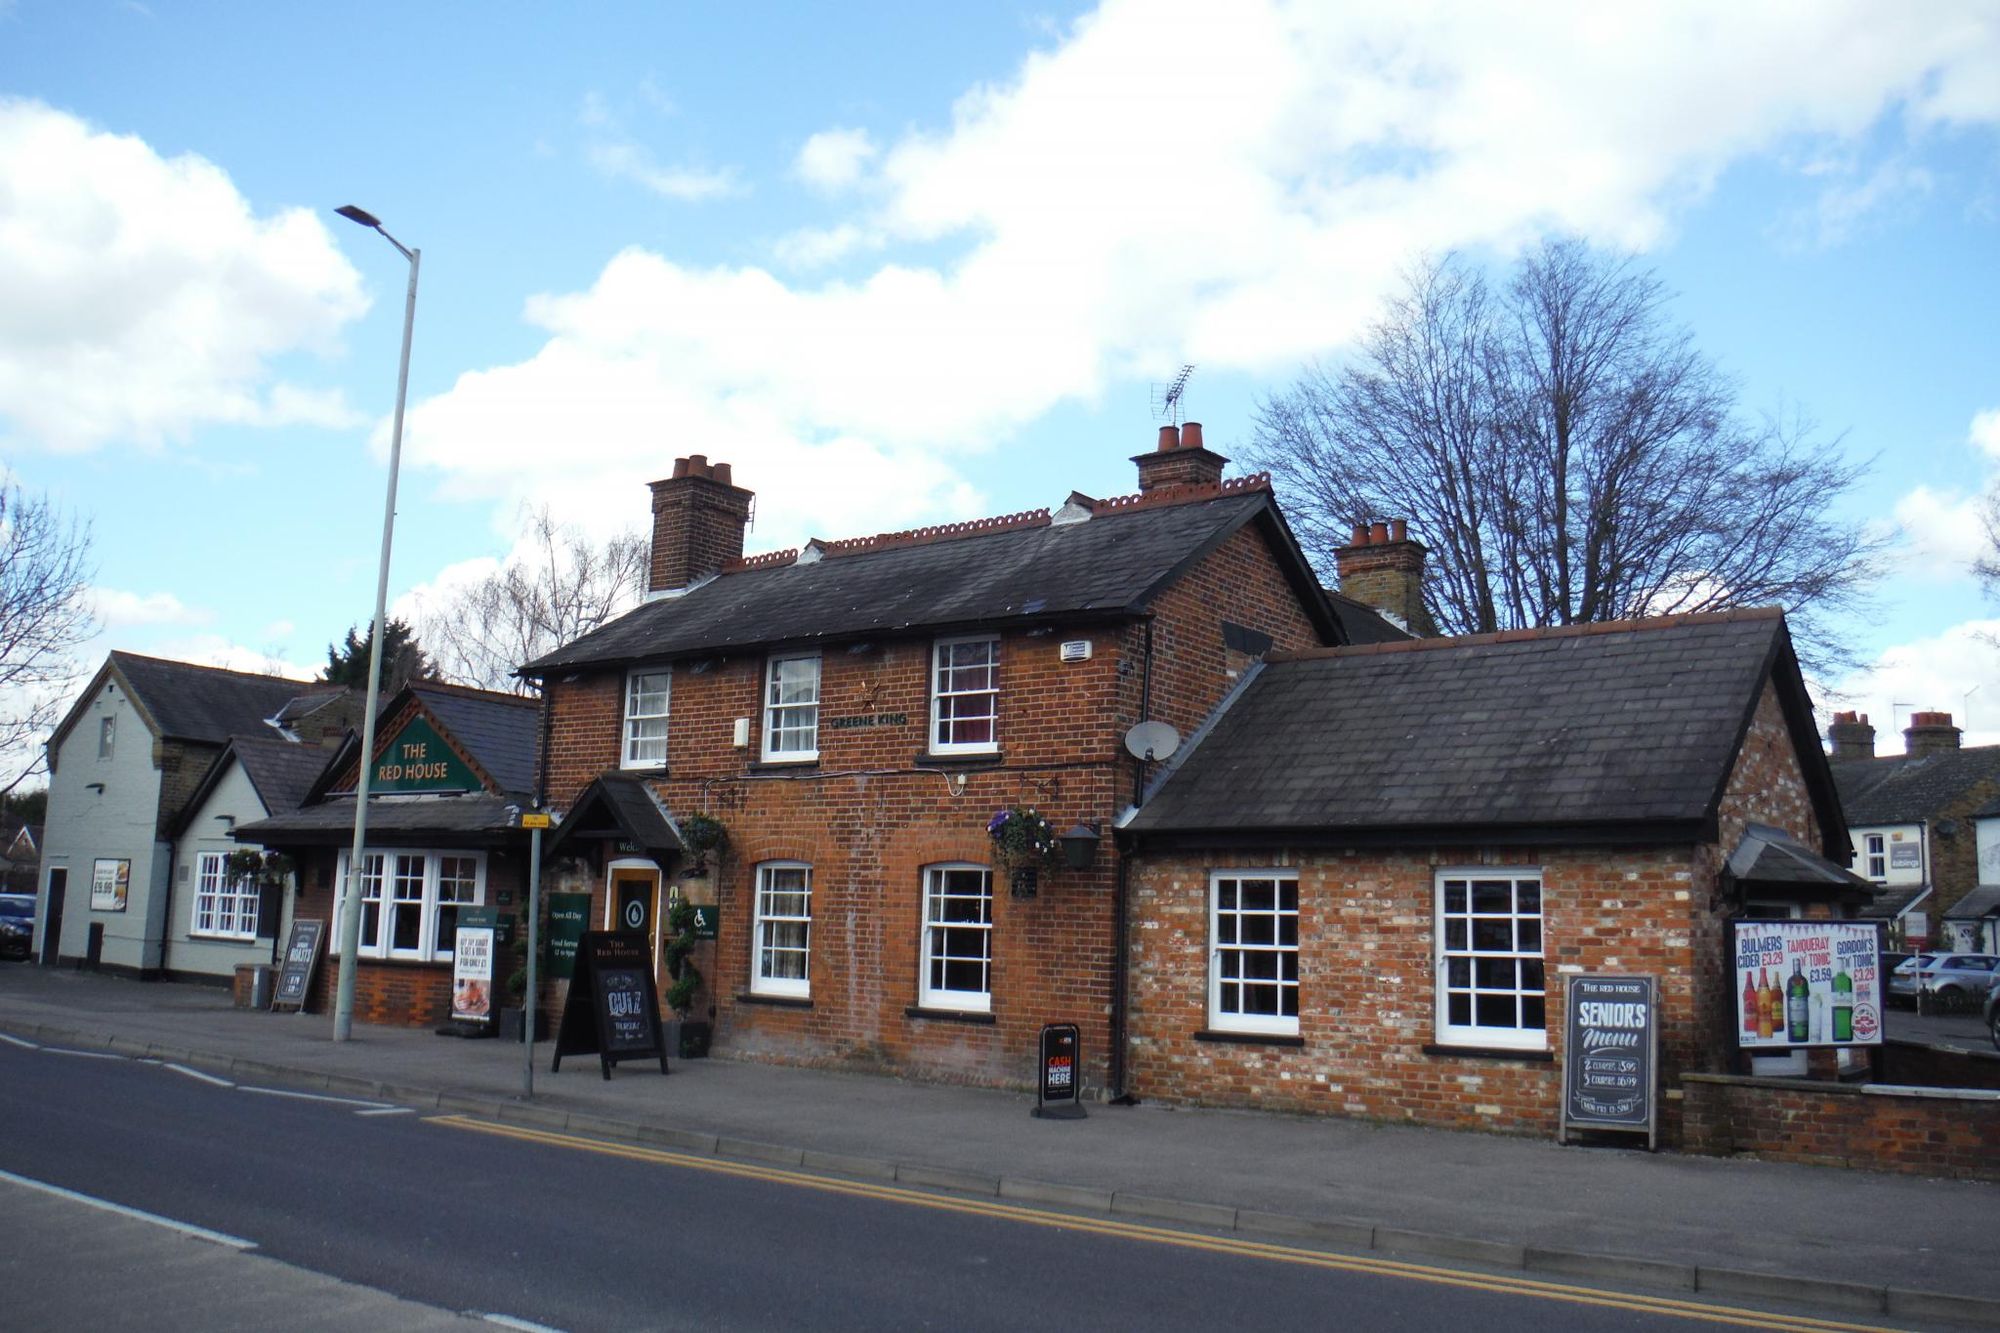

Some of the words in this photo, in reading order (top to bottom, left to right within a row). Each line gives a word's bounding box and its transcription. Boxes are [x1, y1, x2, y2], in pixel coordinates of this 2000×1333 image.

[831, 714, 875, 729] GREENE
[878, 712, 907, 725] KING
[403, 743, 427, 759] THE
[379, 765, 402, 780] RED
[405, 762, 448, 779] HOUSE
[572, 912, 583, 920] Day
[1741, 936, 1783, 954] BULMERS
[1786, 937, 1831, 953] TANQUERAY
[1837, 938, 1874, 955] GORDON'S
[289, 947, 313, 962] ROASTS
[1738, 954, 1760, 968] CIDER
[1762, 951, 1784, 967] £3.29
[1808, 953, 1832, 967] TONIC
[1853, 953, 1875, 968] TONIC
[1810, 968, 1832, 983] £3.59
[1853, 967, 1875, 982] £3.29
[1582, 983, 1598, 993] THE
[1600, 985, 1614, 993] RED
[1615, 985, 1641, 993] HOUSE
[608, 991, 642, 1016] QUIZ
[1579, 1001, 1646, 1028] SENIOR'S
[1582, 1028, 1639, 1048] Menu
[1048, 1056, 1072, 1066] CASH
[1584, 1060, 1592, 1070] 2
[1048, 1073, 1071, 1085] HERE
[1583, 1073, 1590, 1086] 3
